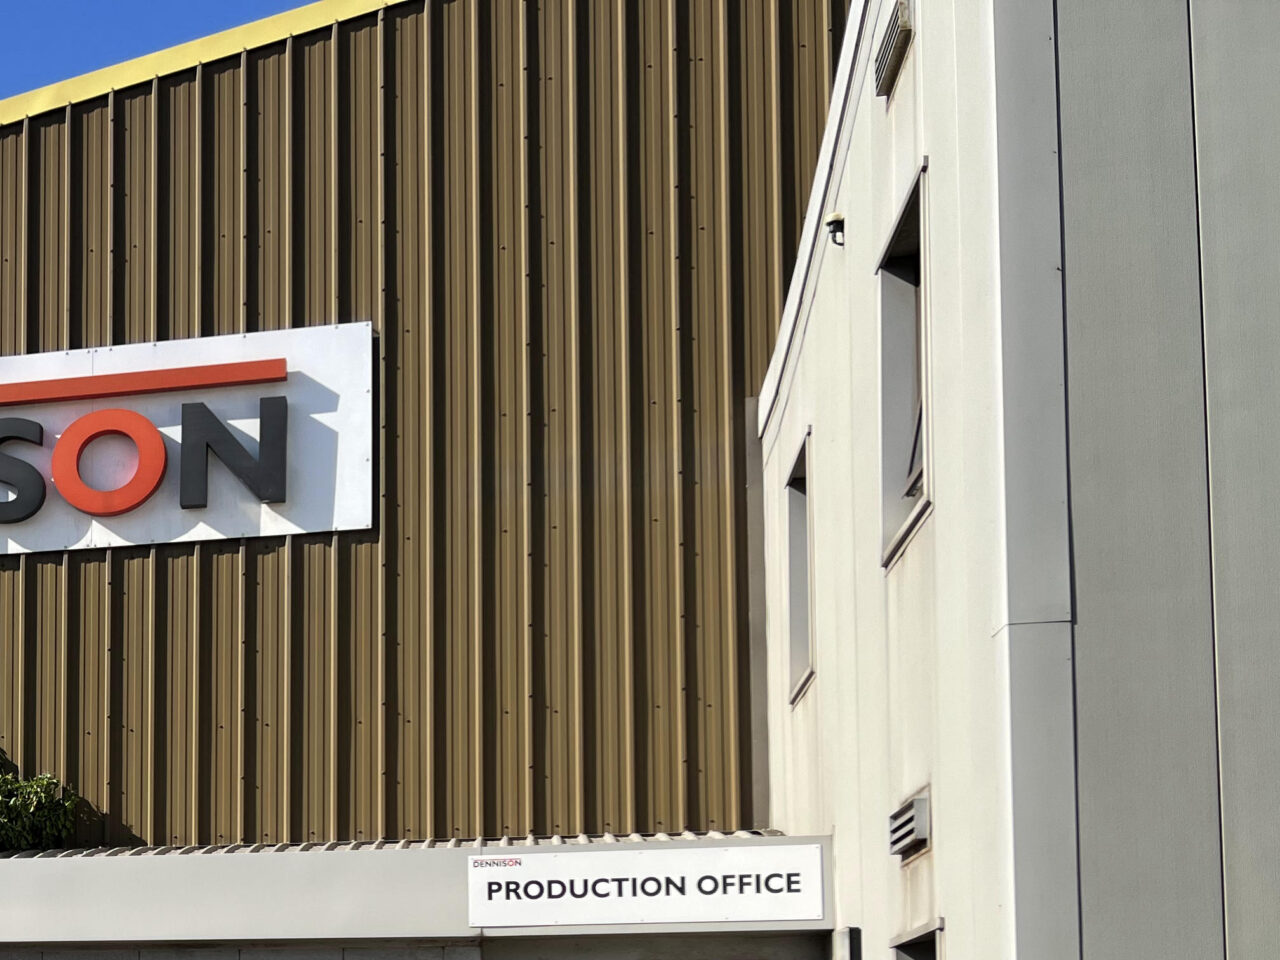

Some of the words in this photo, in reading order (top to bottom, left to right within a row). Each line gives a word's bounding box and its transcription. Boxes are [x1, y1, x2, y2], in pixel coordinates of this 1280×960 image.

[473, 859, 522, 868] DENNISON
[487, 875, 687, 901] PRODUCTION
[697, 872, 802, 896] OFFICE
